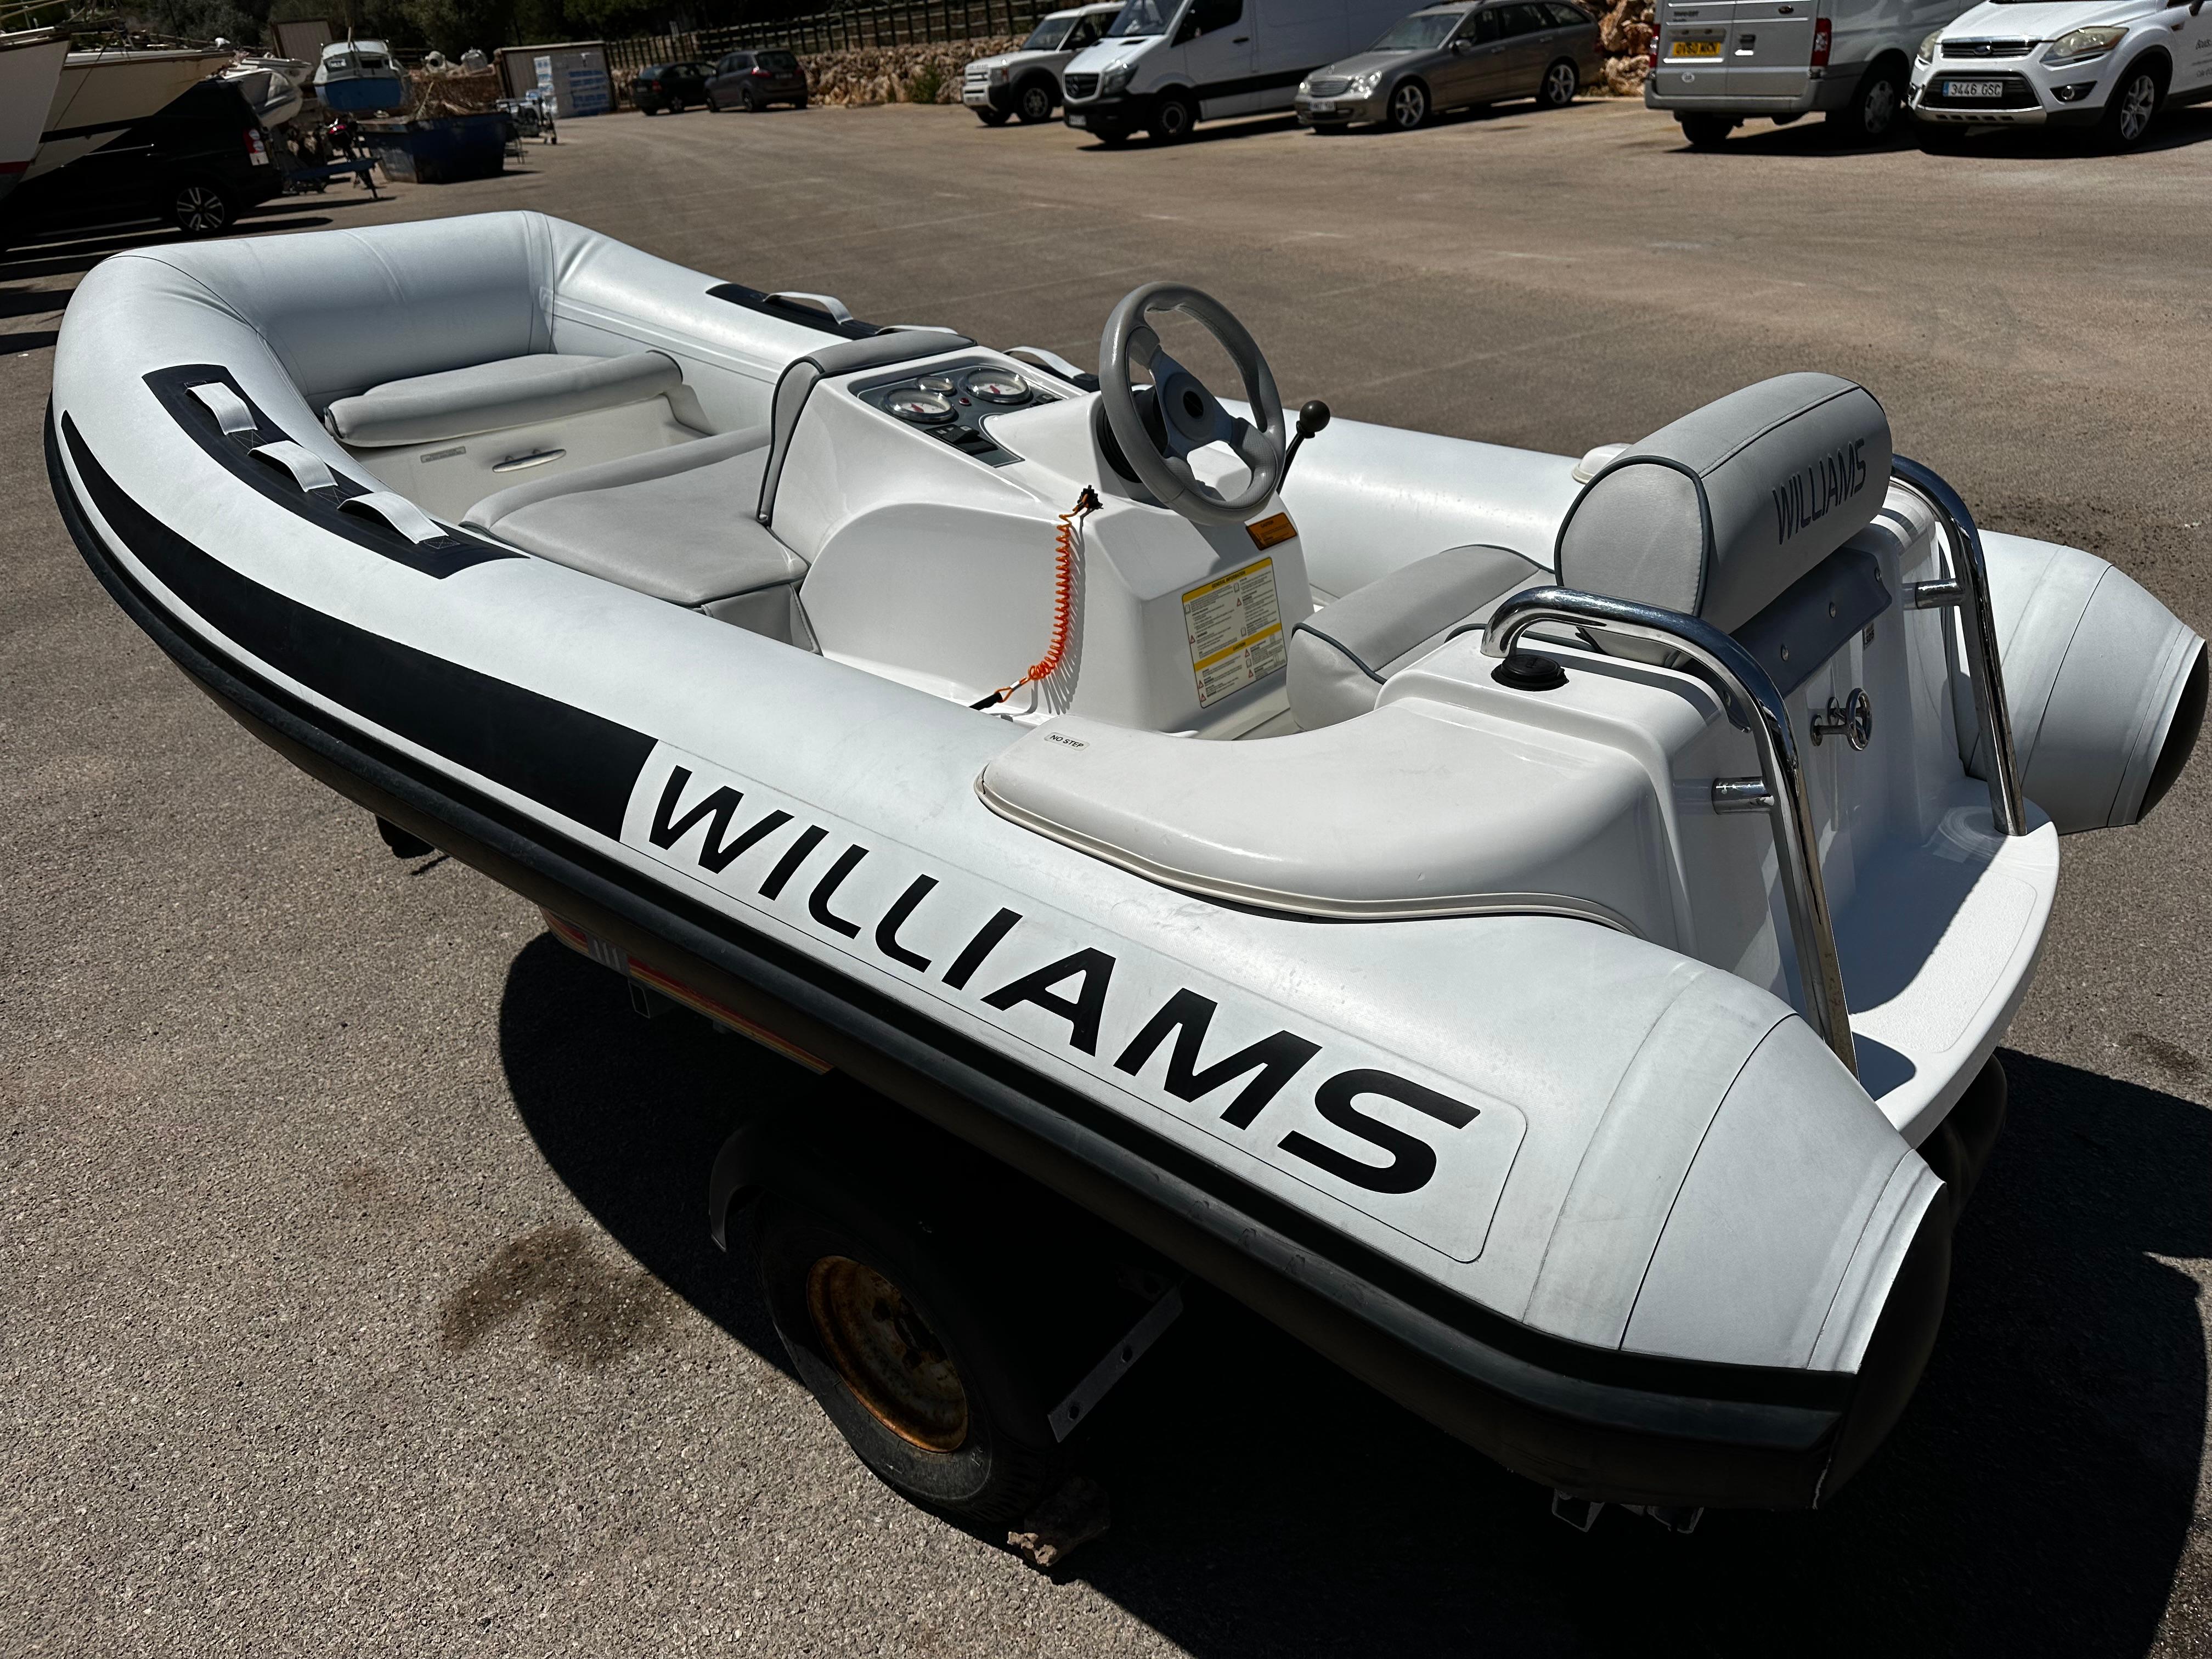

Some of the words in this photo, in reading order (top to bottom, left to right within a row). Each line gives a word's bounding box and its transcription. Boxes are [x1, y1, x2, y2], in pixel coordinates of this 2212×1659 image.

[1951, 83, 1977, 95] 3446
[1981, 83, 2001, 95] GSC
[1772, 438, 1866, 545] WILLIAMS
[1063, 739, 1084, 747] STEP
[648, 765, 1481, 1195] WILLIAMS
